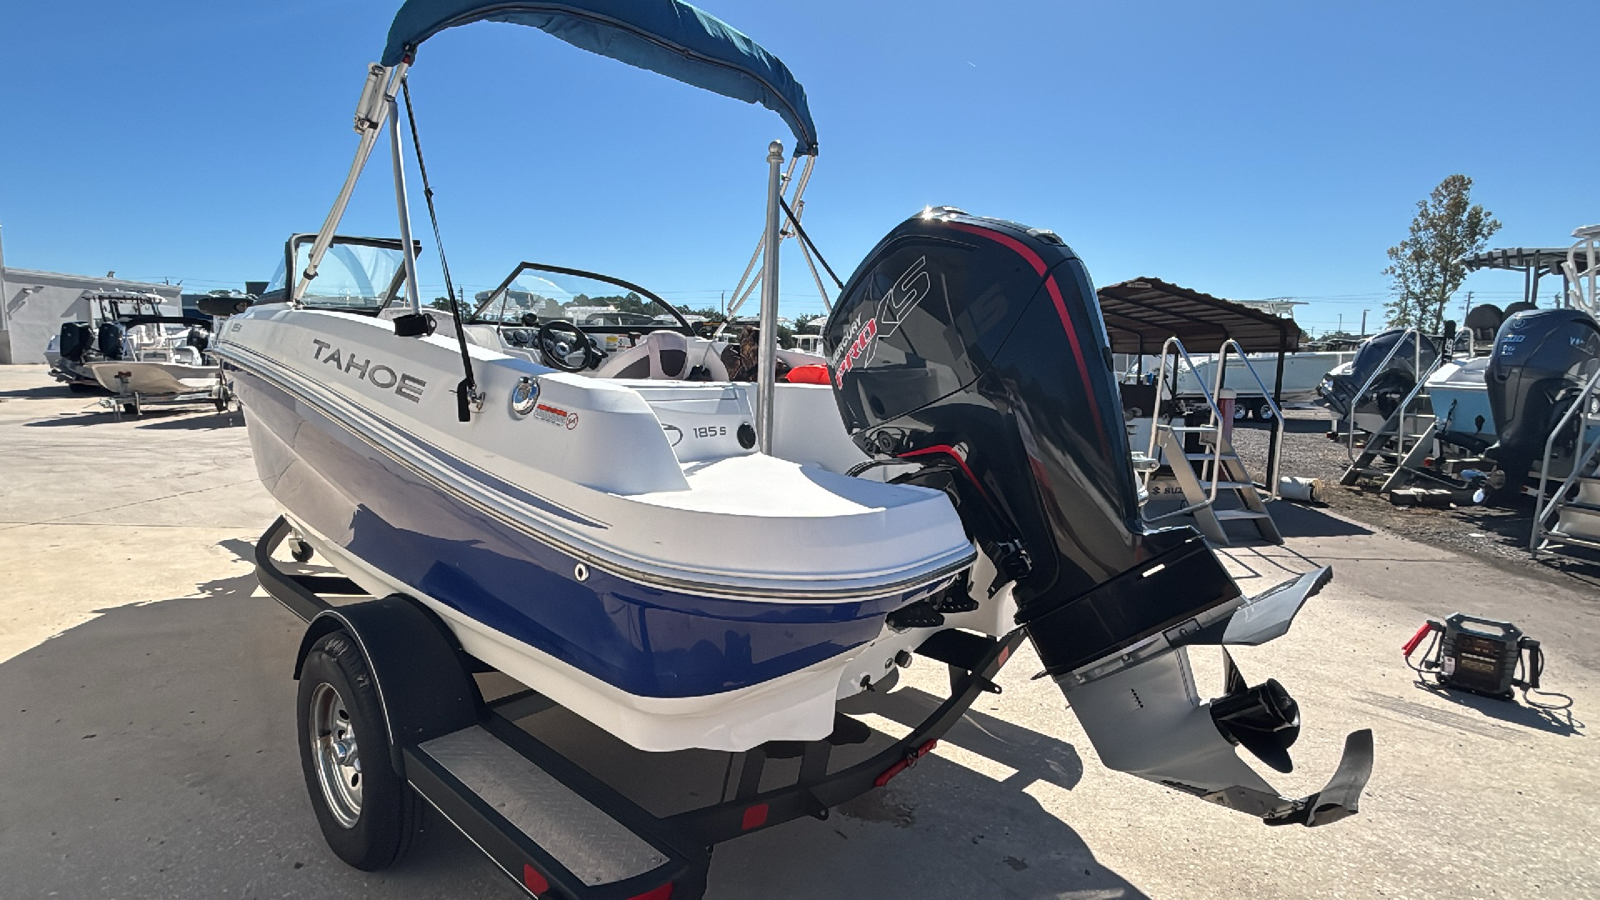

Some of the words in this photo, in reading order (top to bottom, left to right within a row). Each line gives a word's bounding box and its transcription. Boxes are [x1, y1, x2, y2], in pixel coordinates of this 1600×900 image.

[831, 312, 862, 368] MERCURY
[835, 317, 878, 390] PRO
[864, 255, 930, 369] XS
[313, 338, 427, 404] TAHOE
[693, 426, 718, 439] 185
[1164, 486, 1184, 494] SUZ
